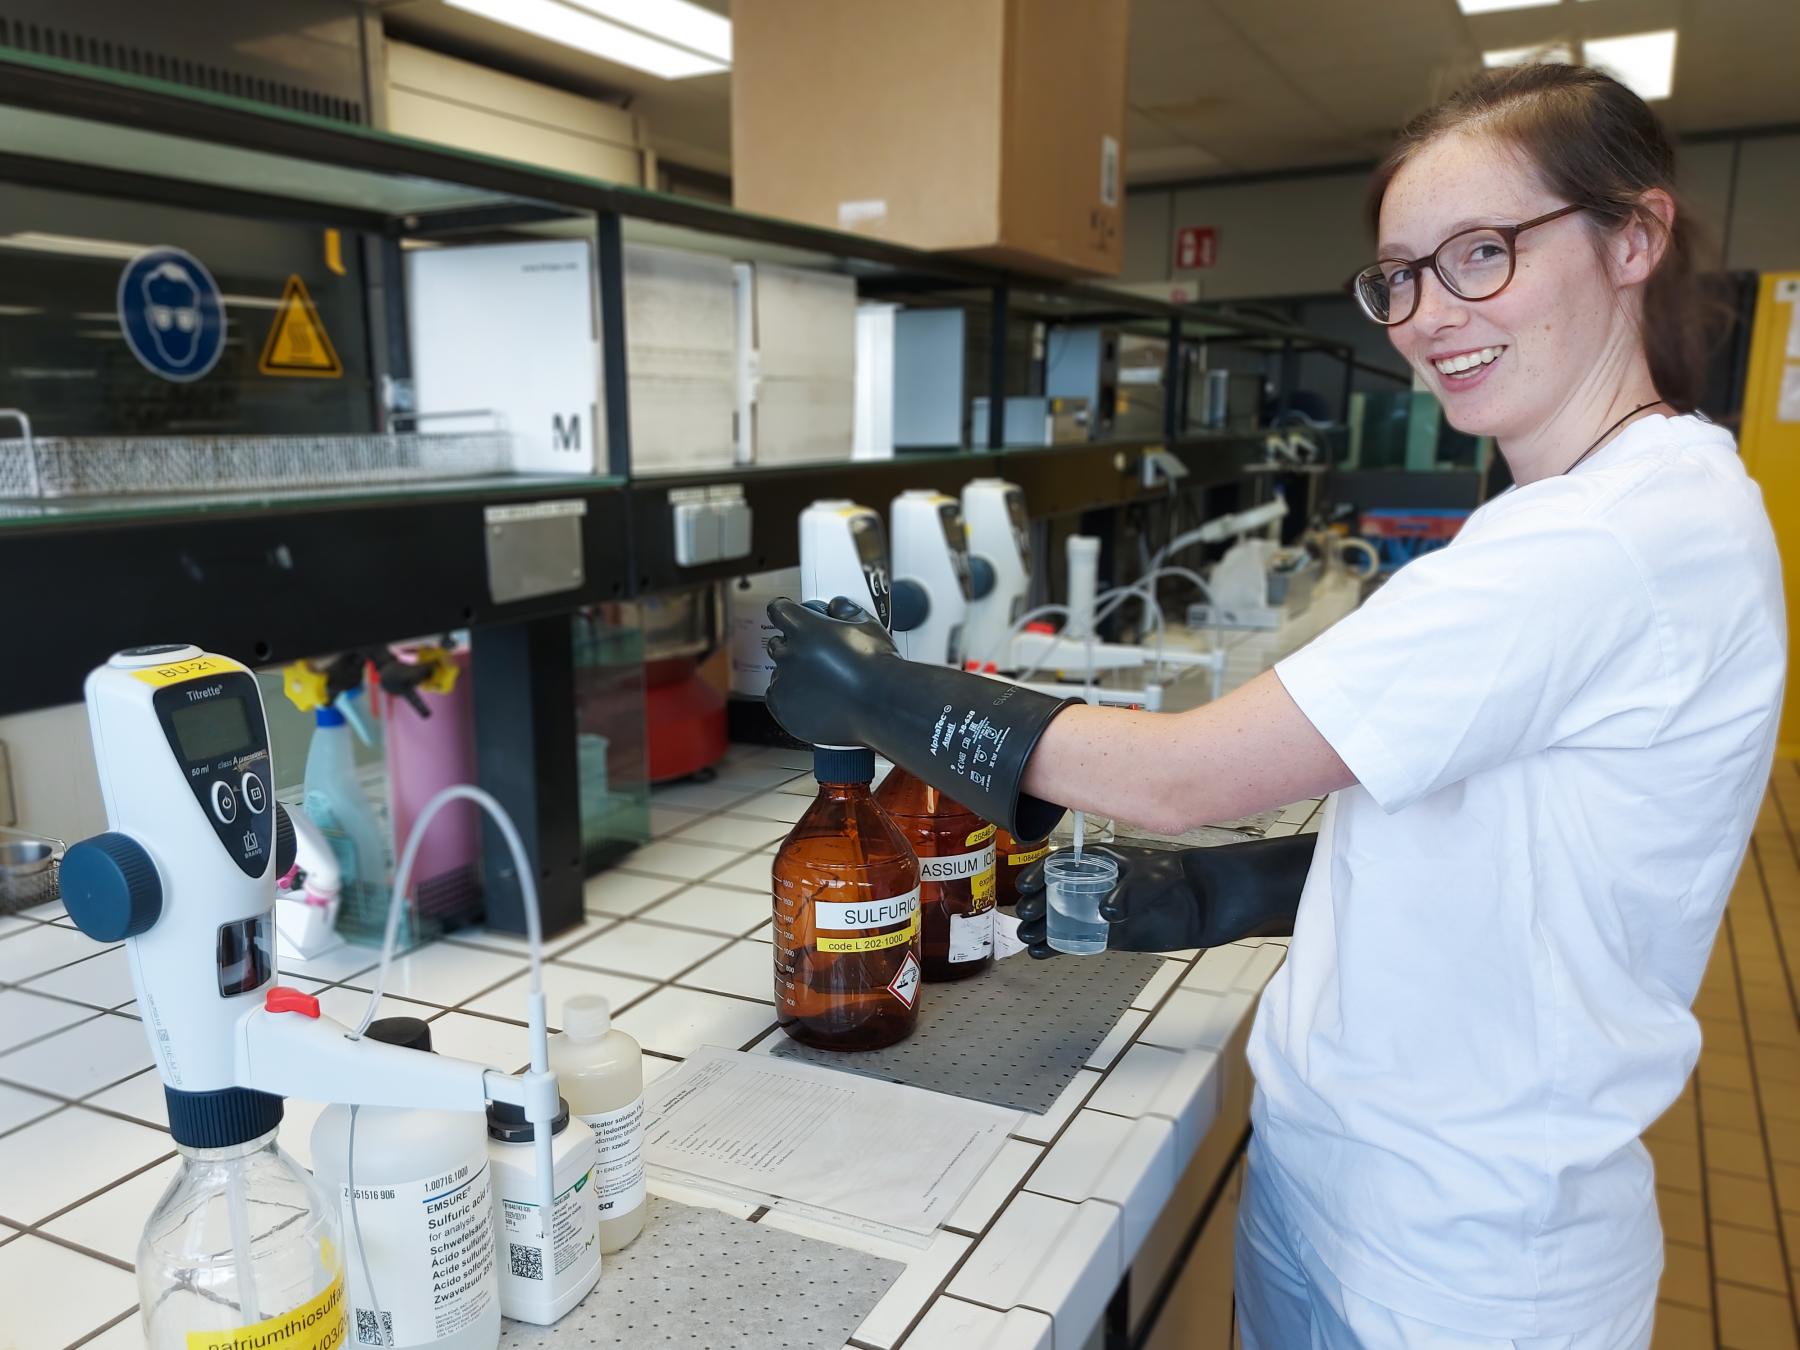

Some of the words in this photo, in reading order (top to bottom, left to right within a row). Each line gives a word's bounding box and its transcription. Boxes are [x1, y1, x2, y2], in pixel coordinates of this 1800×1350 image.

[157, 661, 216, 678] BU-21
[942, 723, 955, 751] Ansell
[200, 764, 209, 774] ml
[218, 760, 232, 769] class
[233, 756, 238, 765] A
[245, 848, 263, 859] BRAND
[921, 858, 978, 877] ASSIUM
[844, 897, 916, 925] SULFURIC
[828, 939, 853, 951] code
[855, 941, 862, 950] L
[587, 1120, 614, 1129] dicator
[380, 1189, 395, 1200] 906
[428, 1204, 470, 1230] Sulfuric
[472, 1187, 486, 1209] acid
[598, 1200, 614, 1211] sar
[429, 1232, 443, 1243] for
[444, 1214, 475, 1238] analysis
[432, 1263, 460, 1280] Acide
[433, 1275, 461, 1293] Acido
[434, 1272, 482, 1304] Zwavelzuur
